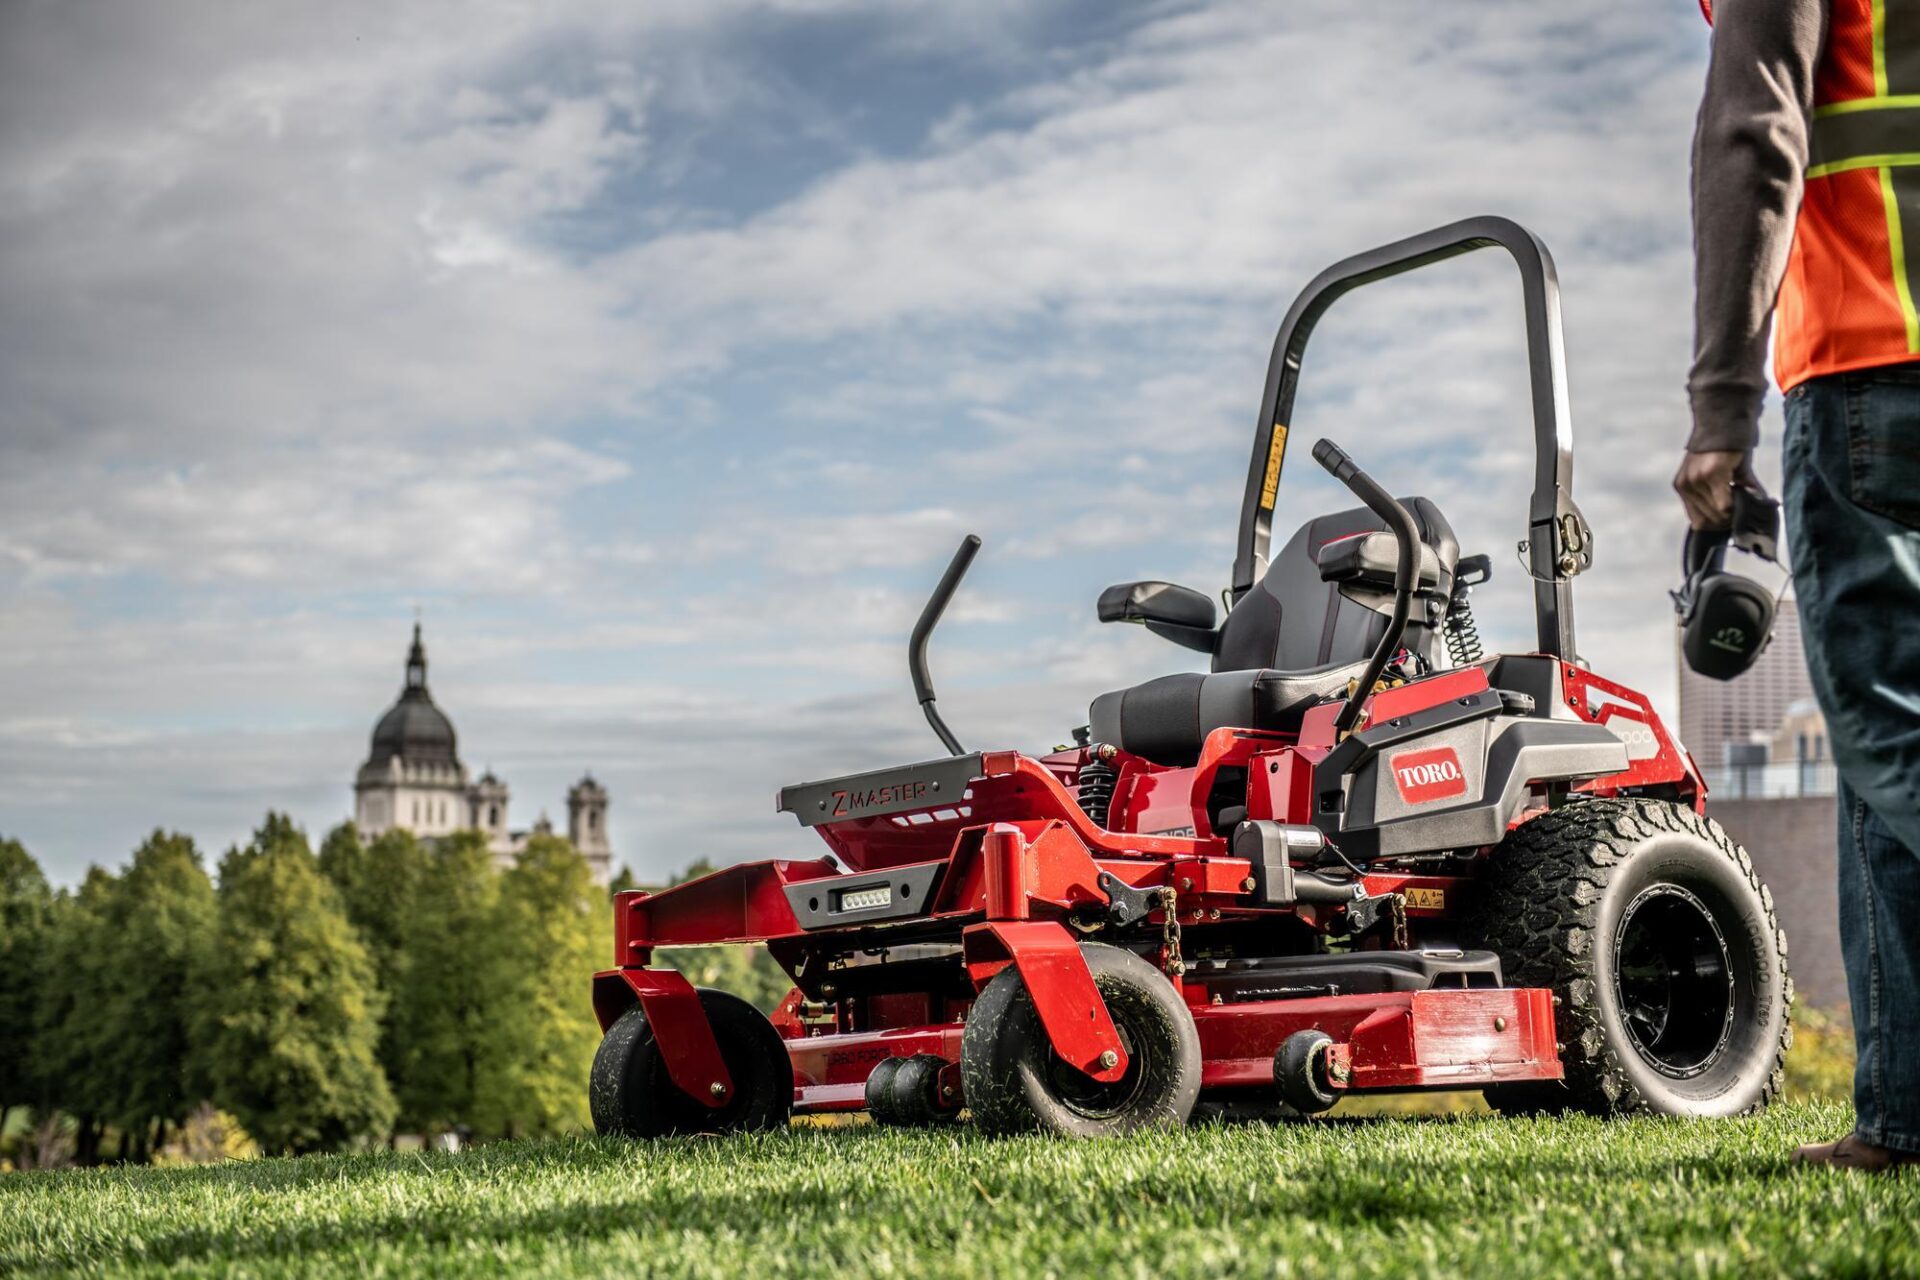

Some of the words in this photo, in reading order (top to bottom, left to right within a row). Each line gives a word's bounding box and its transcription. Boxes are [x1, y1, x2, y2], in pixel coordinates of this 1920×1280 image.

[832, 790, 848, 816] Z
[850, 782, 927, 809] MASTER
[1744, 911, 1770, 983] VOODOO
[822, 1051, 855, 1066] TURBO
